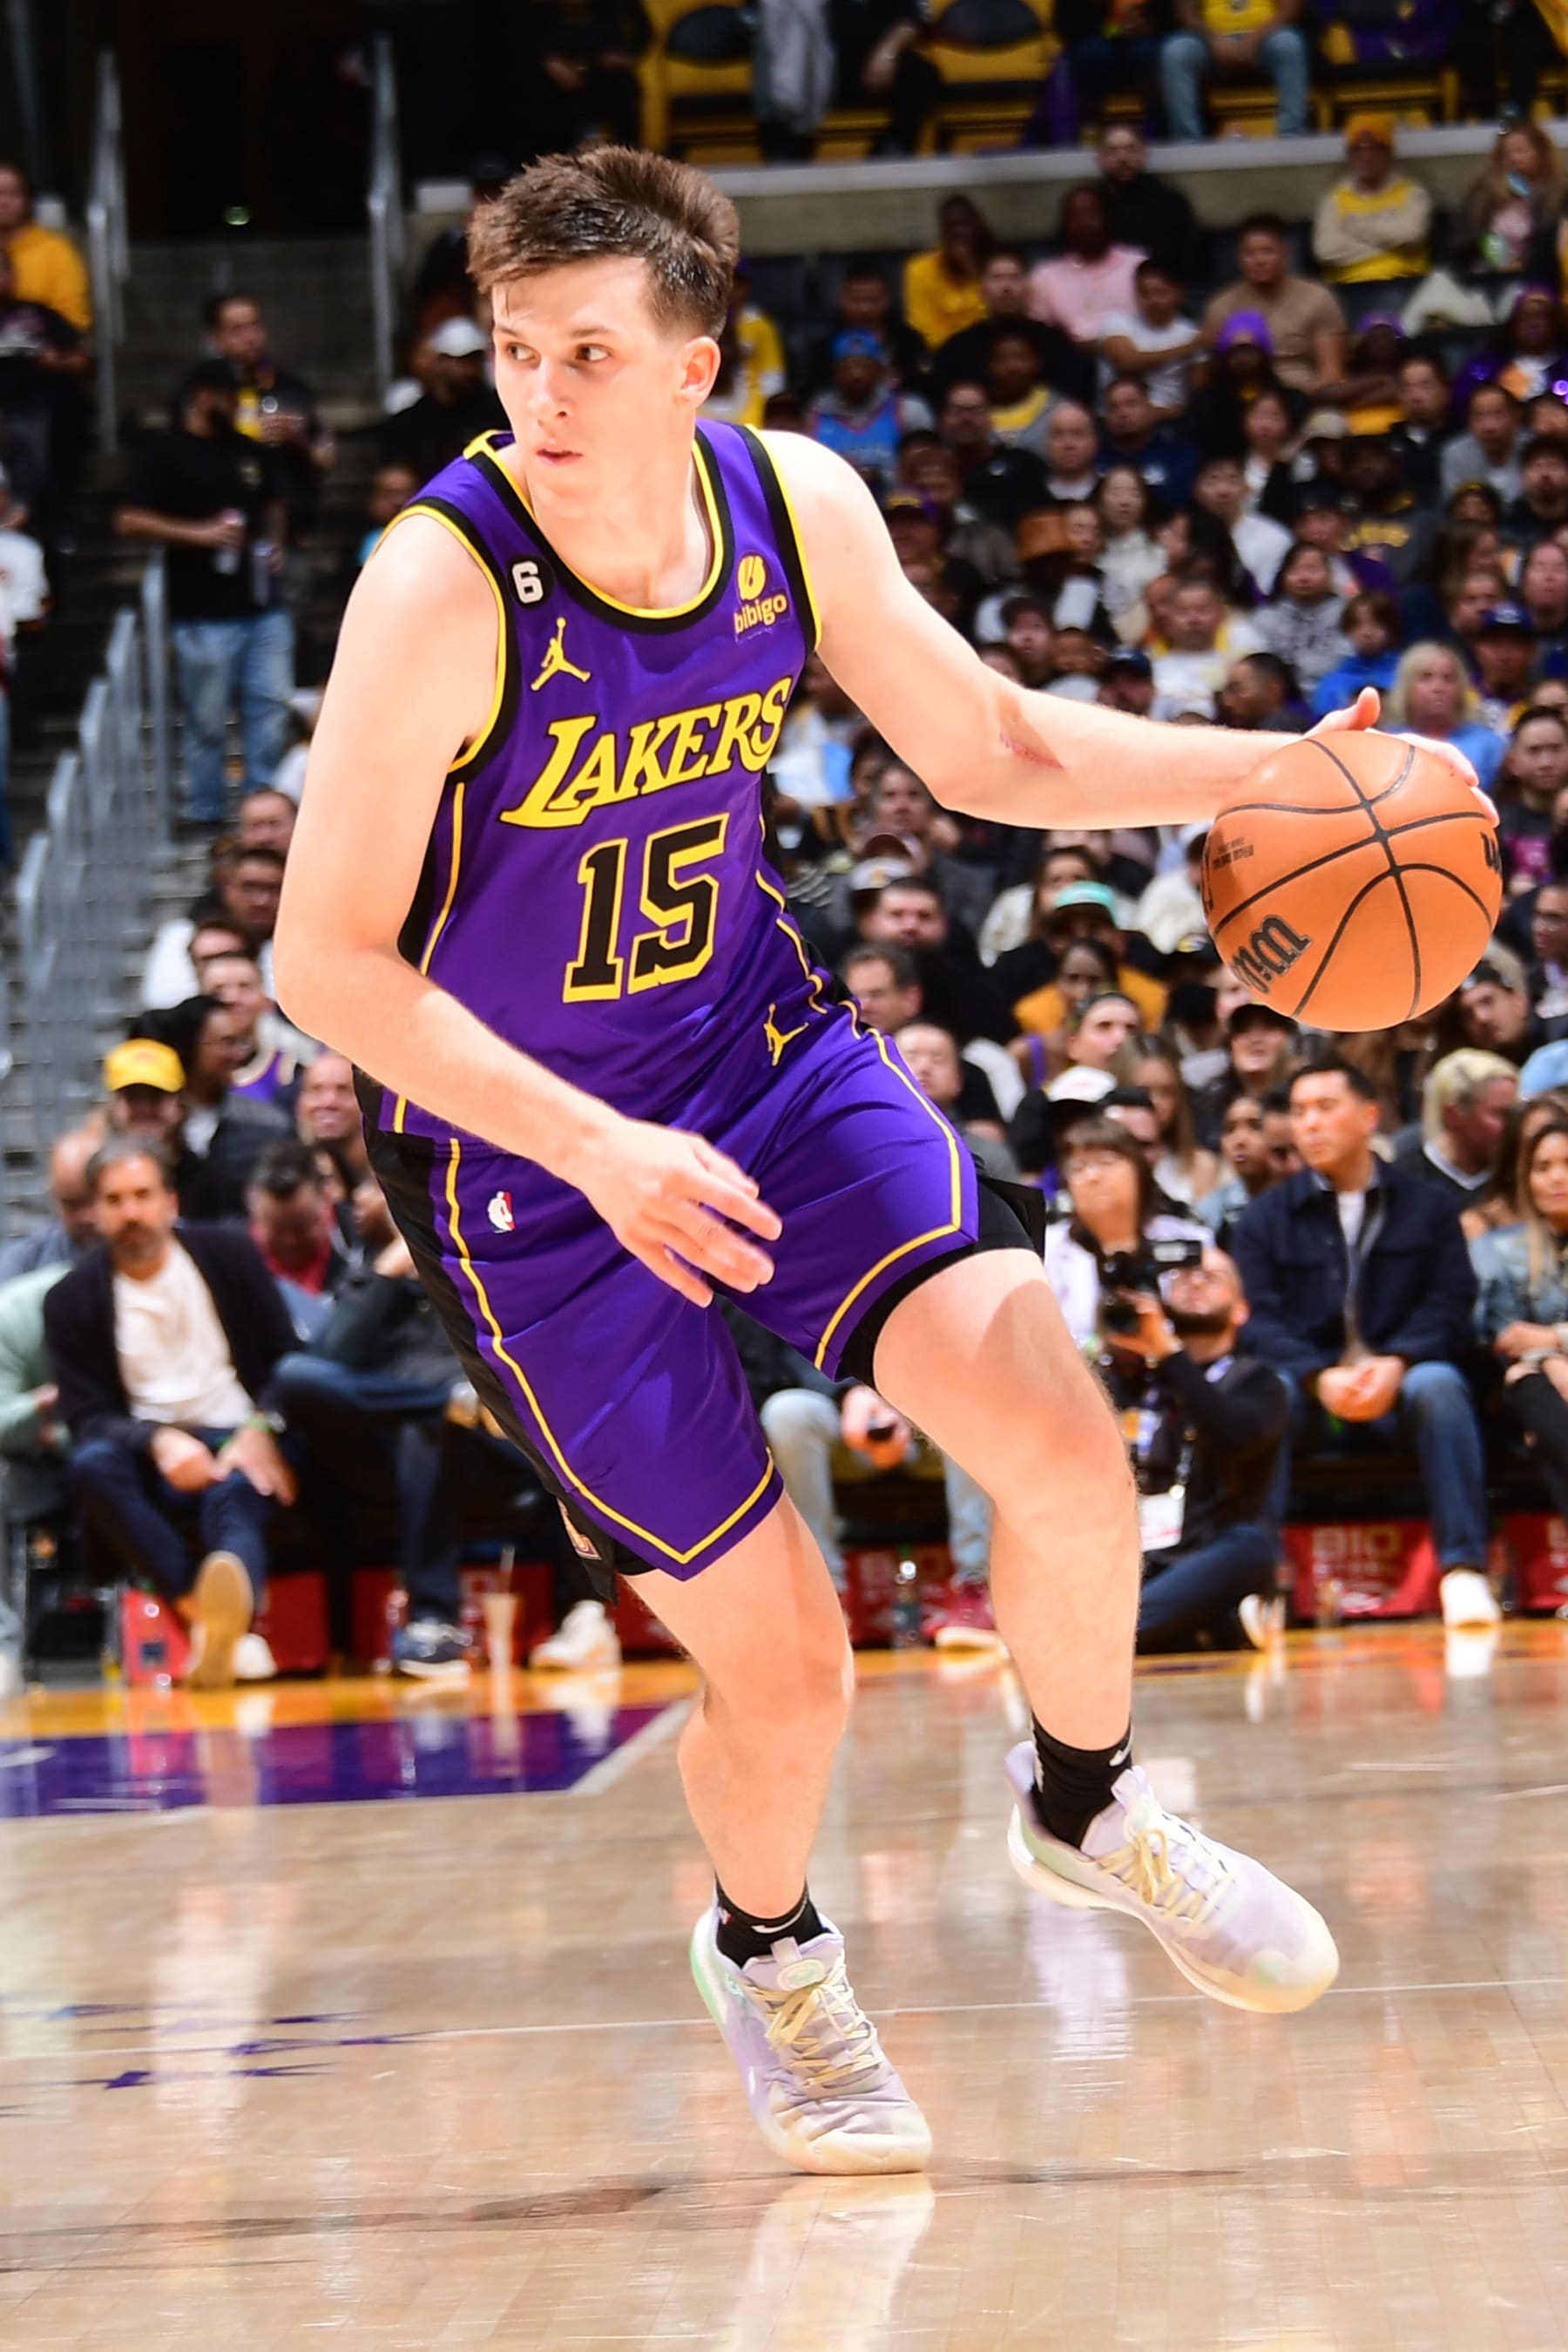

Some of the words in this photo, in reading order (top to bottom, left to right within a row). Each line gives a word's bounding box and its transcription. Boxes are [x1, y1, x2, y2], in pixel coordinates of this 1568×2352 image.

[511, 560, 544, 605] 6
[733, 594, 787, 634] bibigo
[499, 676, 793, 828] LAKERS
[563, 812, 730, 1004] 15
